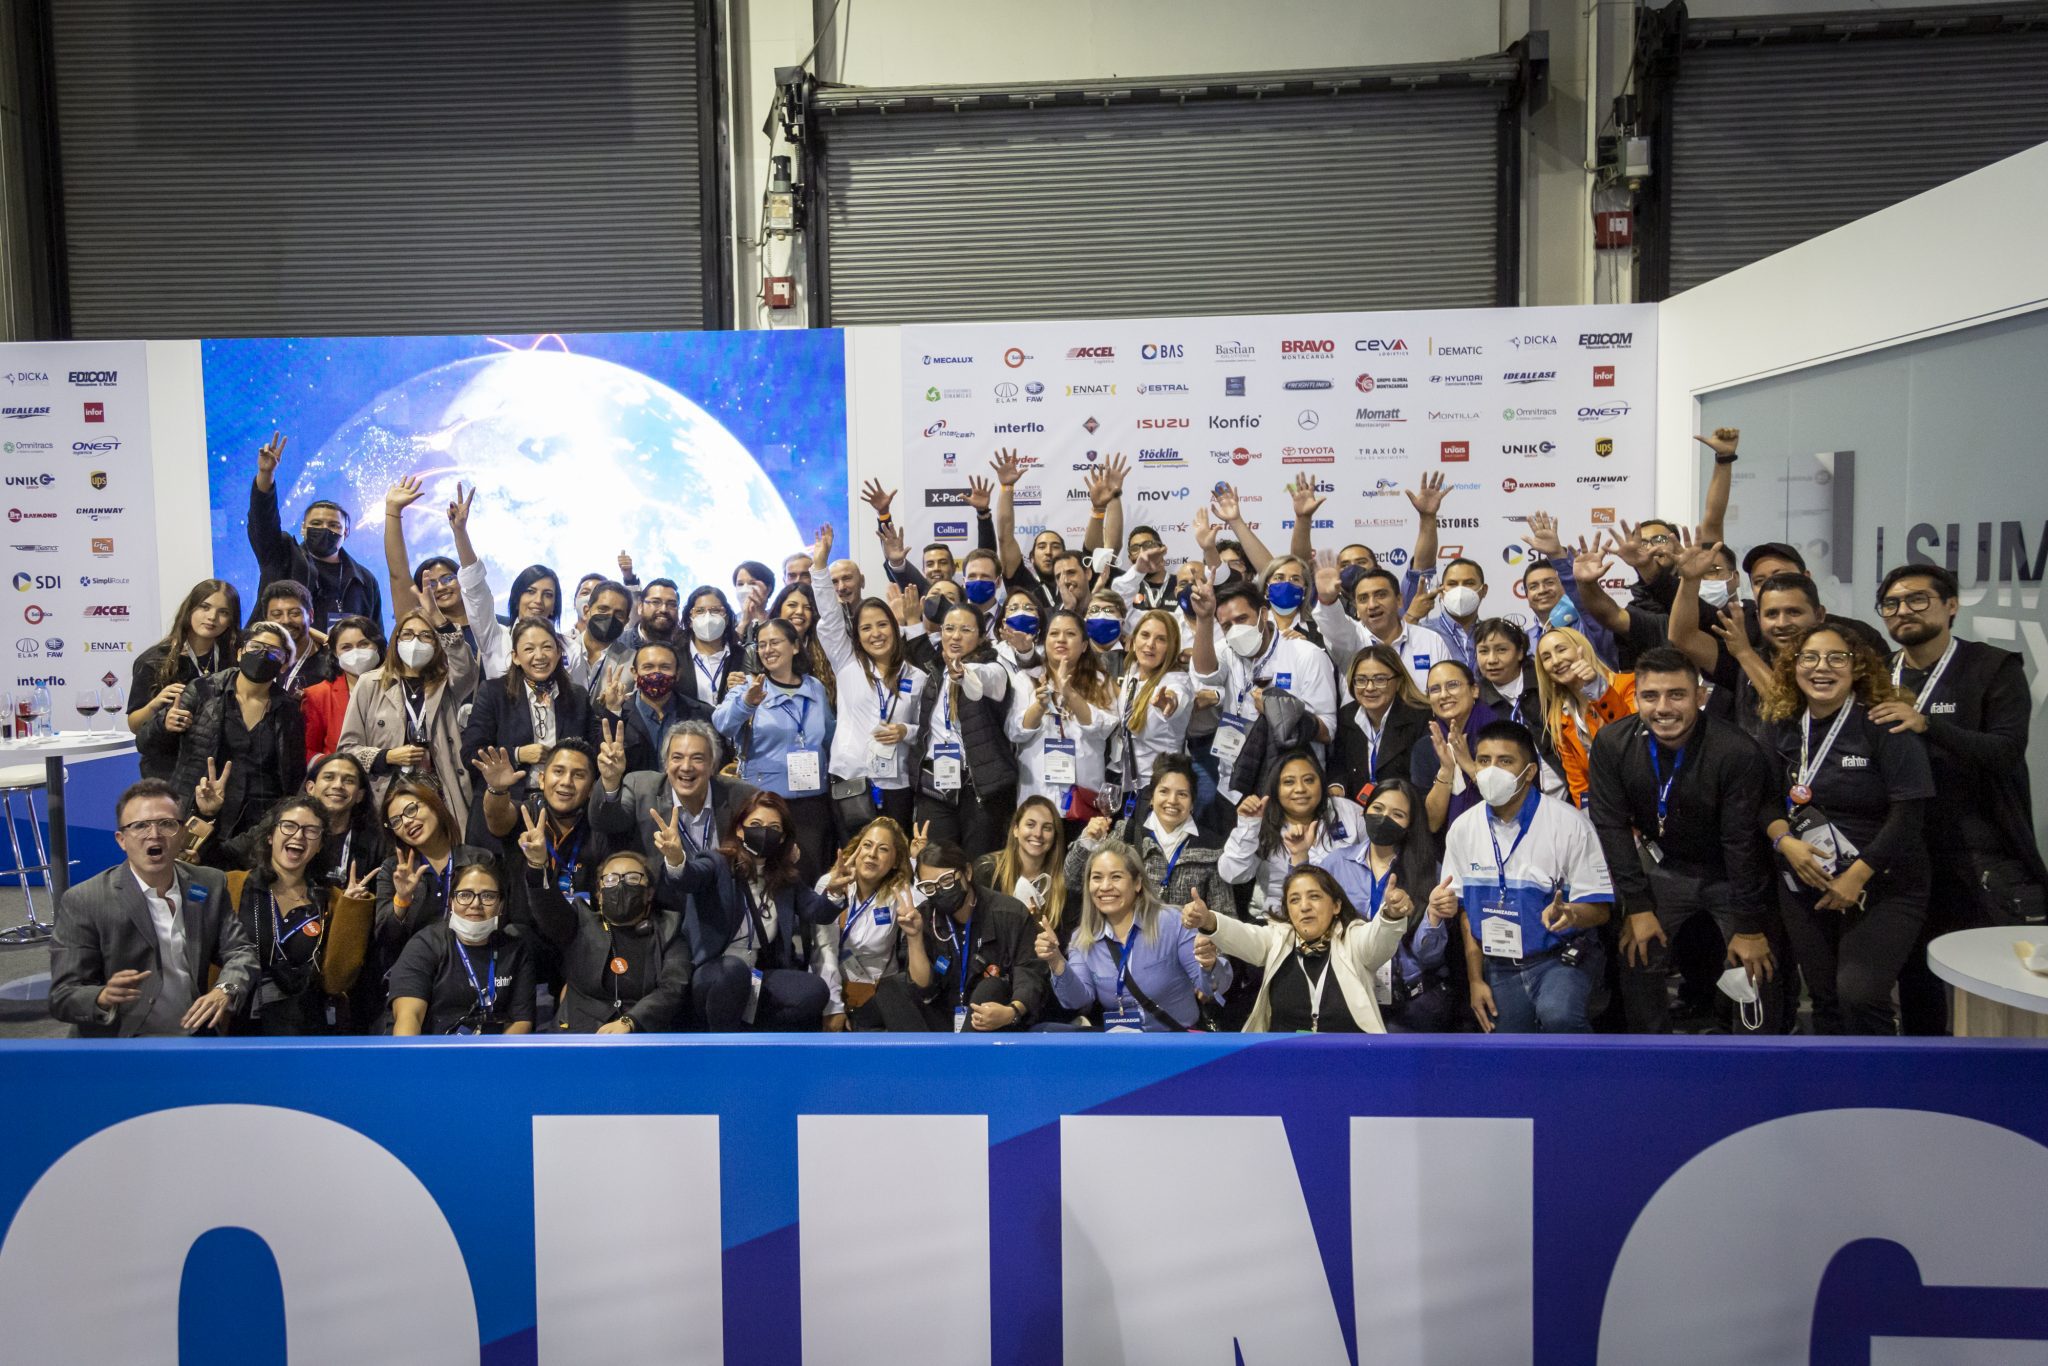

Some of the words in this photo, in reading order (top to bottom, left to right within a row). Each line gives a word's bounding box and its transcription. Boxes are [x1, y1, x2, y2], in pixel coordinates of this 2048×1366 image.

[1524, 336, 1557, 345] DICKA
[1578, 333, 1633, 346] EDICOM
[1160, 344, 1184, 358] BAS
[1215, 344, 1256, 355] Bastian
[1281, 340, 1335, 353] BRAVO
[1438, 346, 1483, 356] DEMATIC
[1075, 346, 1115, 358] ACCEL
[934, 356, 973, 364] MECALUX
[18, 373, 48, 381] DICKA
[68, 371, 118, 383] EDICOM
[1503, 371, 1557, 380] IDEALEASE
[1594, 372, 1613, 380] infor
[1073, 385, 1110, 394] ENNAT
[1148, 384, 1189, 392] ESTRAL
[2, 406, 51, 414] IDEALEASE
[85, 406, 103, 416] infor
[1355, 408, 1400, 420] Momatt
[1516, 408, 1557, 416] Omnitracs
[1577, 408, 1631, 416] ONEST
[1428, 410, 1480, 421] MONTILLA
[994, 422, 1044, 433] interflo
[1137, 418, 1189, 429] ISUZU
[16, 441, 53, 450] Omnitracs
[72, 442, 122, 450] ONEST
[1596, 442, 1612, 452] ups
[1138, 448, 1179, 459] Stöcklin
[1210, 450, 1230, 458] Ticket
[1298, 447, 1334, 455] TOYOTA
[91, 477, 107, 488] ups
[1436, 518, 1480, 529] ASTORES
[936, 525, 965, 534] Colliers
[36, 575, 61, 589] SDI
[1599, 578, 1627, 588] CCEL
[92, 605, 130, 615] ACCEL
[91, 642, 125, 650] ENNAT
